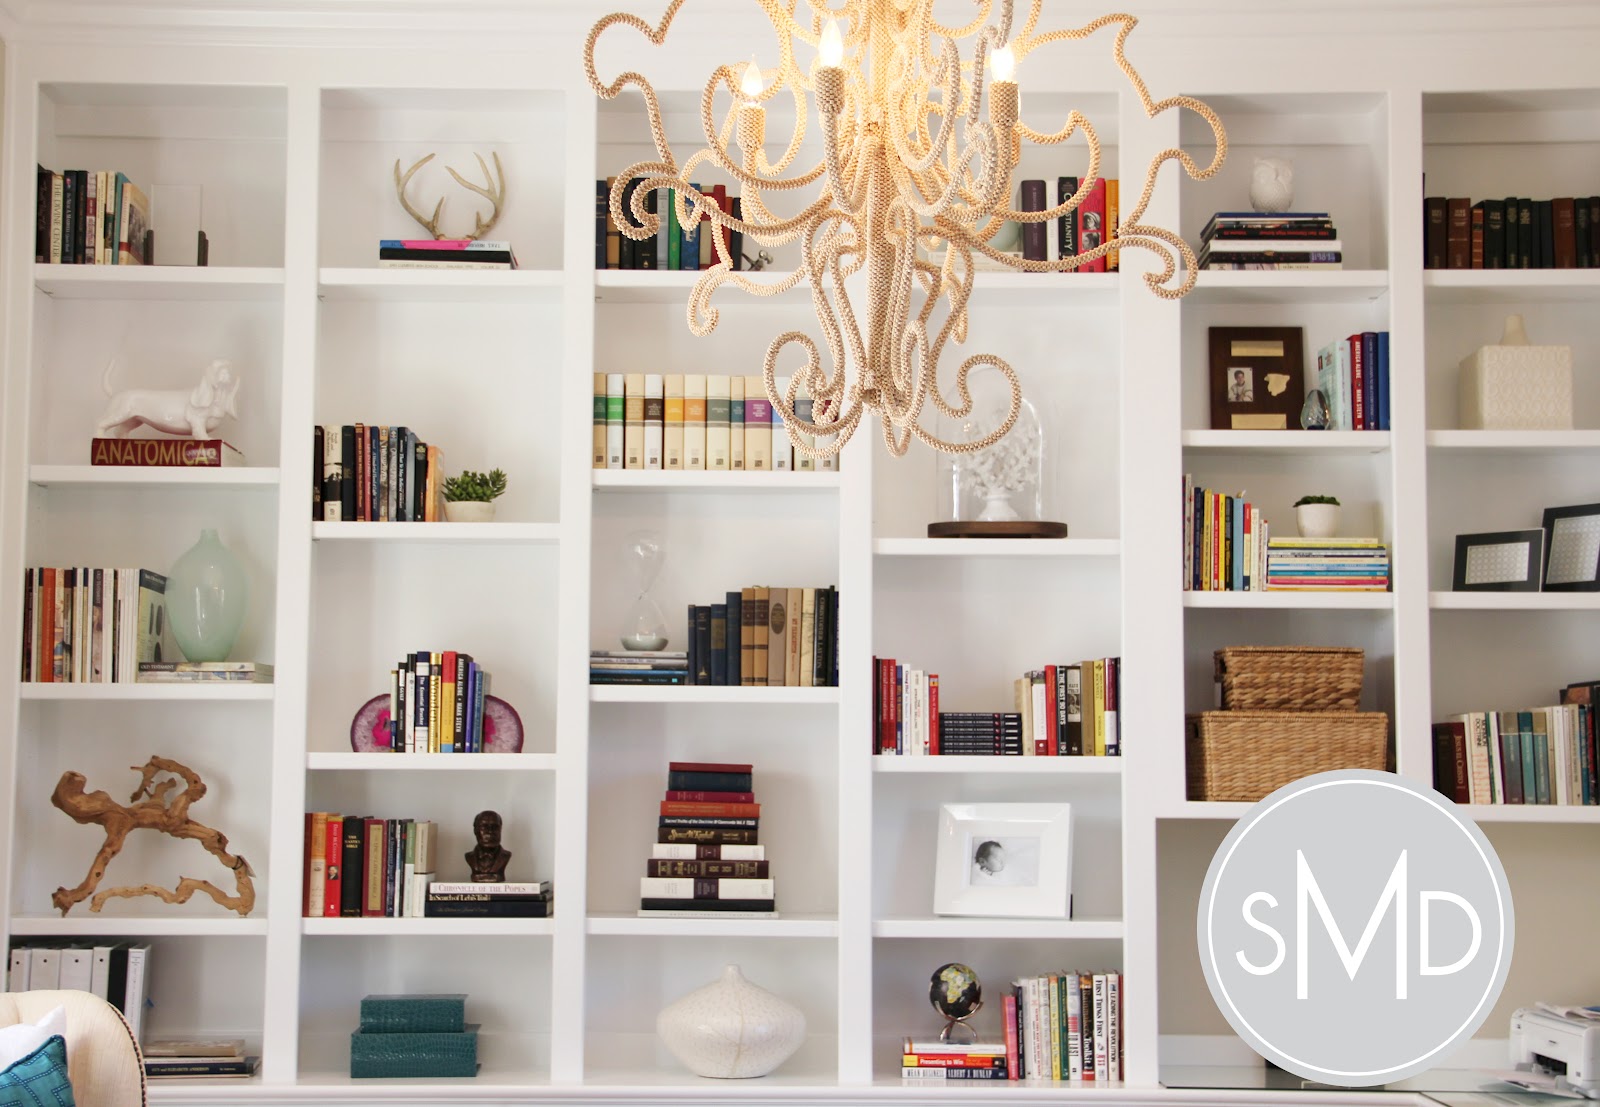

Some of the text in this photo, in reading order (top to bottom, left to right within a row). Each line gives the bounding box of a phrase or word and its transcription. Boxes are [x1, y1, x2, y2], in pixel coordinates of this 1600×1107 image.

[53, 199, 61, 225] DIVINE
[1063, 192, 1073, 250] CSTIANITY
[53, 227, 61, 258] CENTER
[95, 440, 209, 465] ANATOMICA
[816, 597, 825, 669] CHRISTOPHER LAYTON
[429, 677, 439, 723] Wooden
[1060, 702, 1066, 710] 90
[438, 884, 475, 892] CHRONICLE
[504, 884, 526, 892] POPES
[1095, 980, 1103, 997] FIRST
[1069, 1043, 1078, 1057] LAST
[1083, 1037, 1092, 1064] Toolkit
[920, 1058, 946, 1066] Presenting
[907, 1069, 920, 1077] MEAN
[947, 1069, 966, 1078] ALBERT
[972, 1069, 992, 1078] DUNLAP
